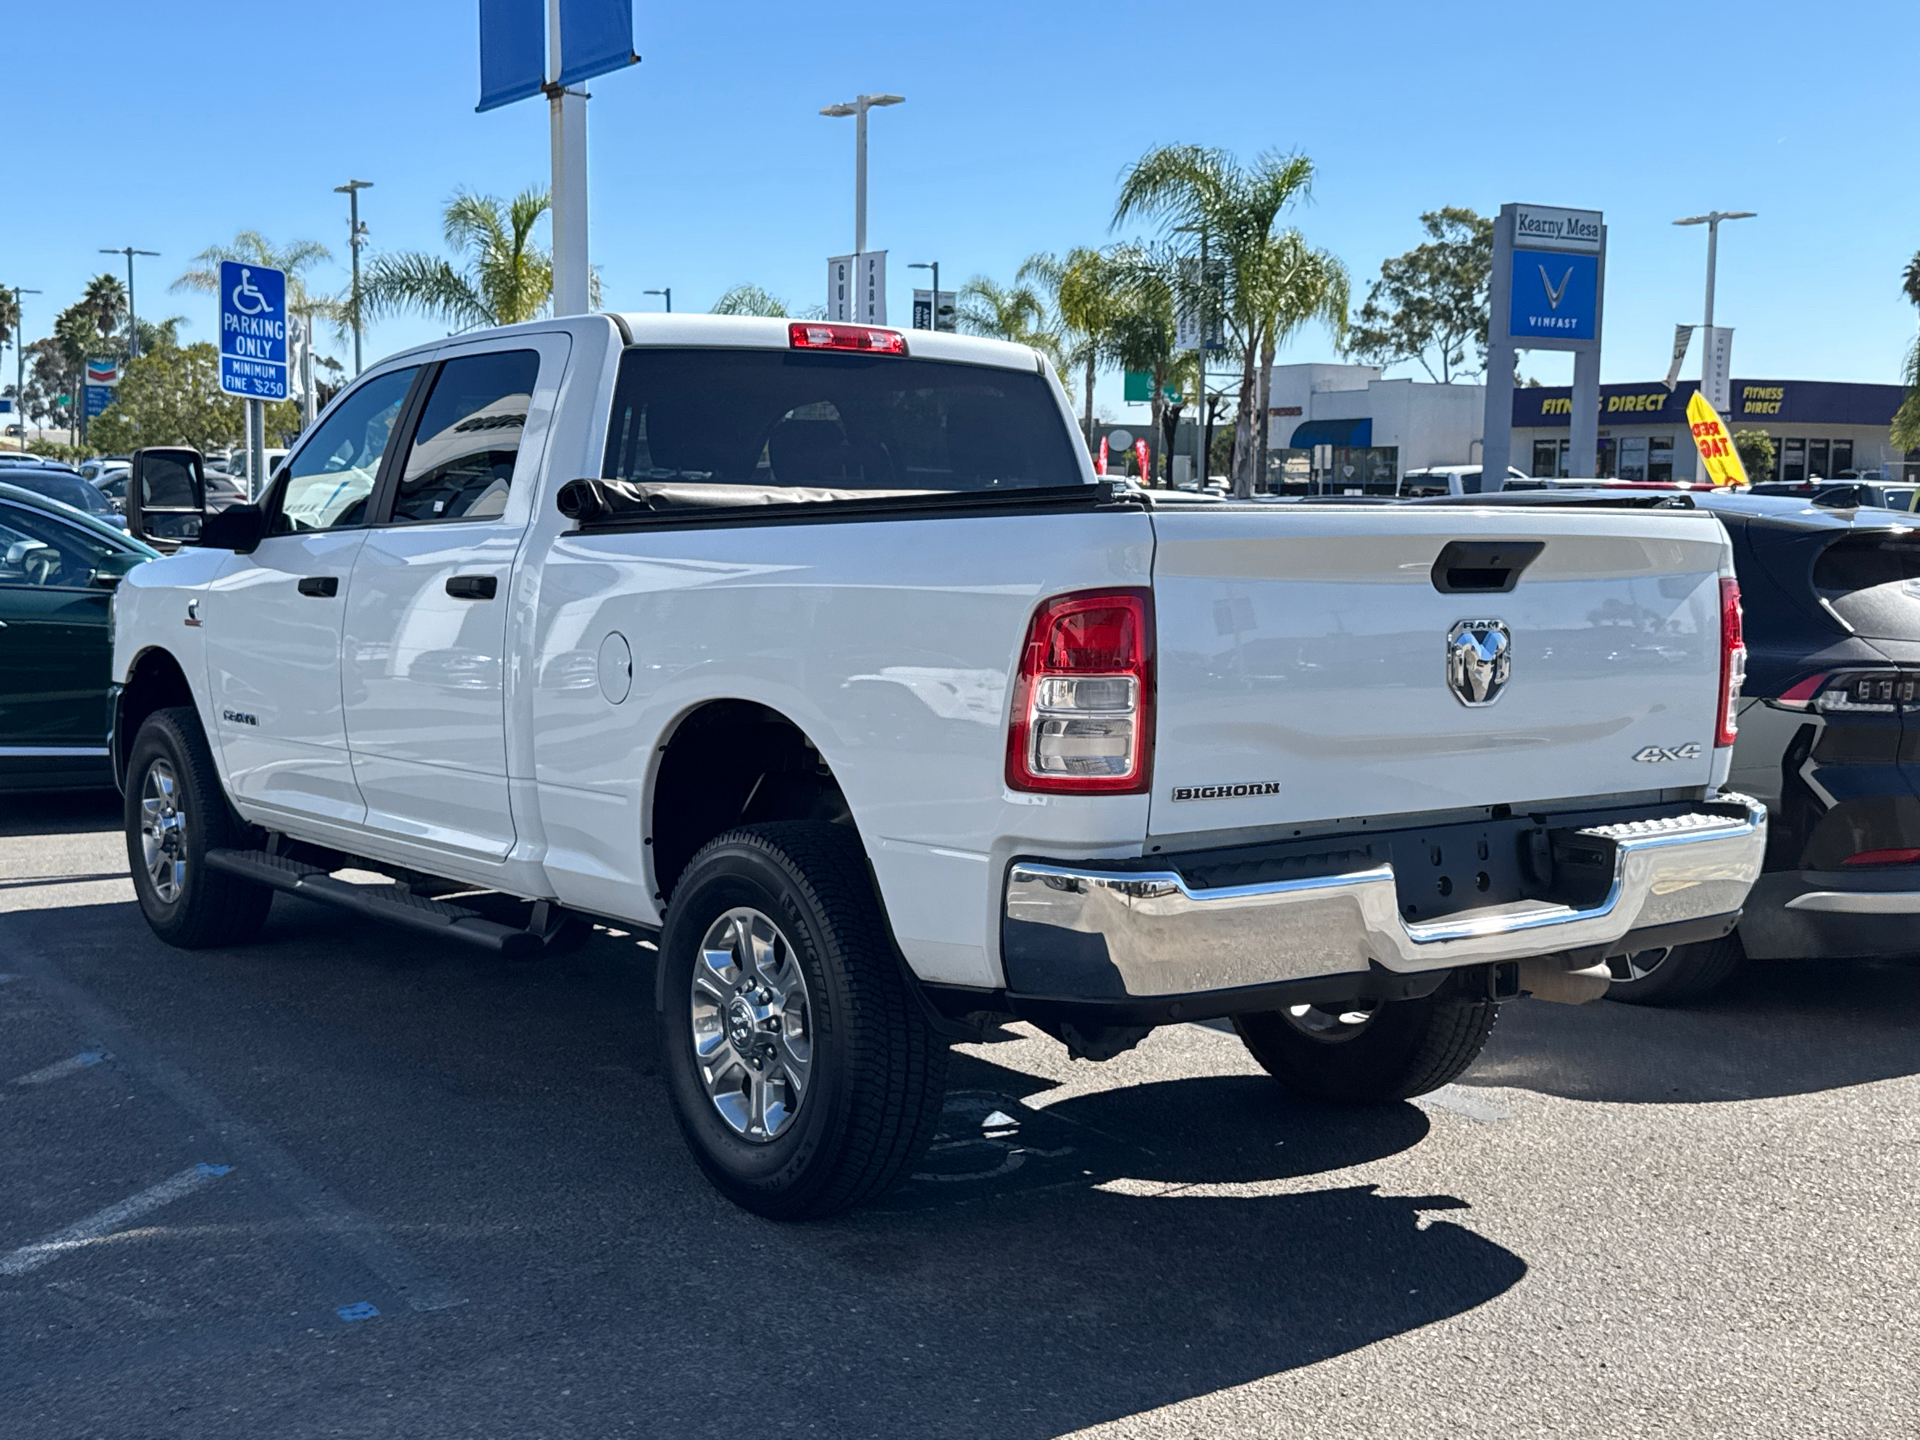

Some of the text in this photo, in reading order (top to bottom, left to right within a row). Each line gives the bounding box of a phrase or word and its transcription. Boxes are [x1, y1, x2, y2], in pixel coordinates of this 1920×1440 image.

[1518, 213, 1599, 240] Kearny Mesa
[224, 312, 284, 340] PARKING
[1528, 316, 1578, 330] VINFAST
[235, 335, 273, 359] ONLY
[232, 360, 276, 379] MINIMUM
[1715, 338, 1724, 402] CHRYSLER
[225, 375, 284, 396] FINE $250
[1742, 385, 1785, 401] FITNESS
[1541, 393, 1668, 415] FITNS DIRECT
[1743, 401, 1782, 415] DIRECT
[1463, 621, 1499, 630] RAM
[1172, 780, 1281, 802] BIGHORN
[795, 919, 833, 1034] MICHELIN
